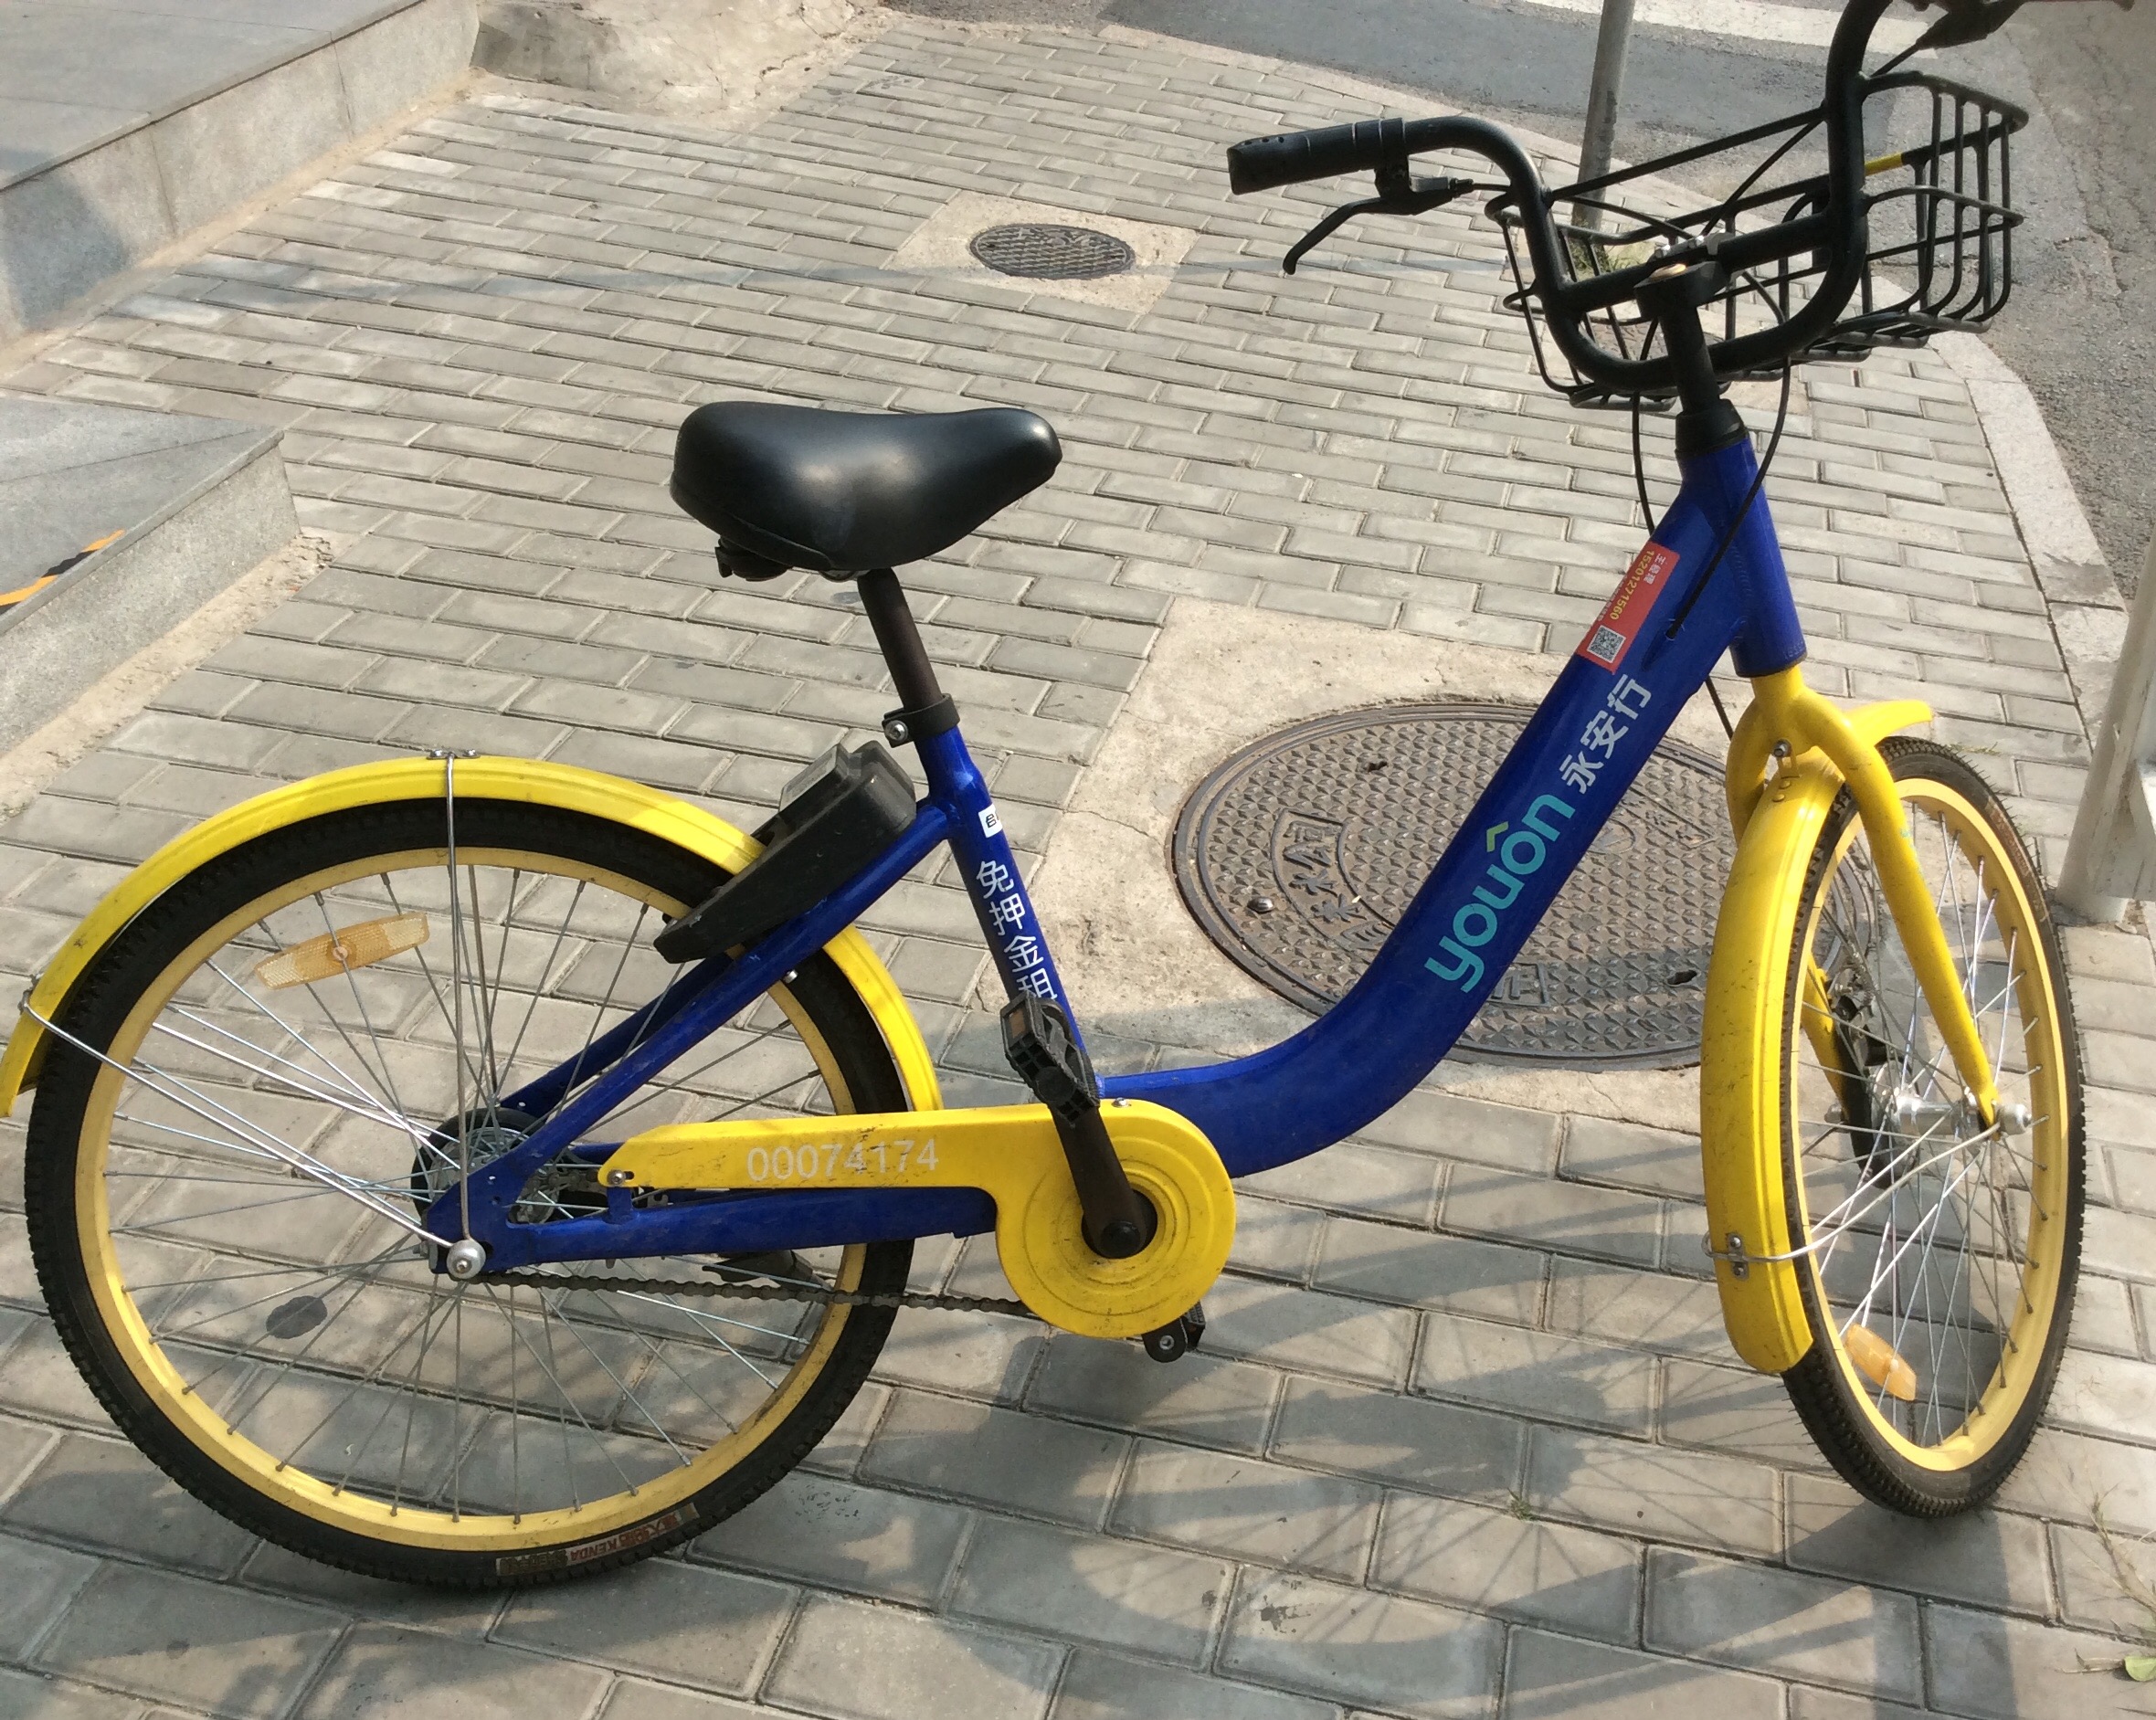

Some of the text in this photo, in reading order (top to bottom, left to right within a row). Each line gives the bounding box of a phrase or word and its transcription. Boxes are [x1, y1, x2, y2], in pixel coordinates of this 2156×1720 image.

[1610, 550, 1654, 620] 15201271560
[1559, 674, 1652, 795] 永安行
[747, 1138, 939, 1182] 00074174
[570, 1538, 618, 1562] KENDA
